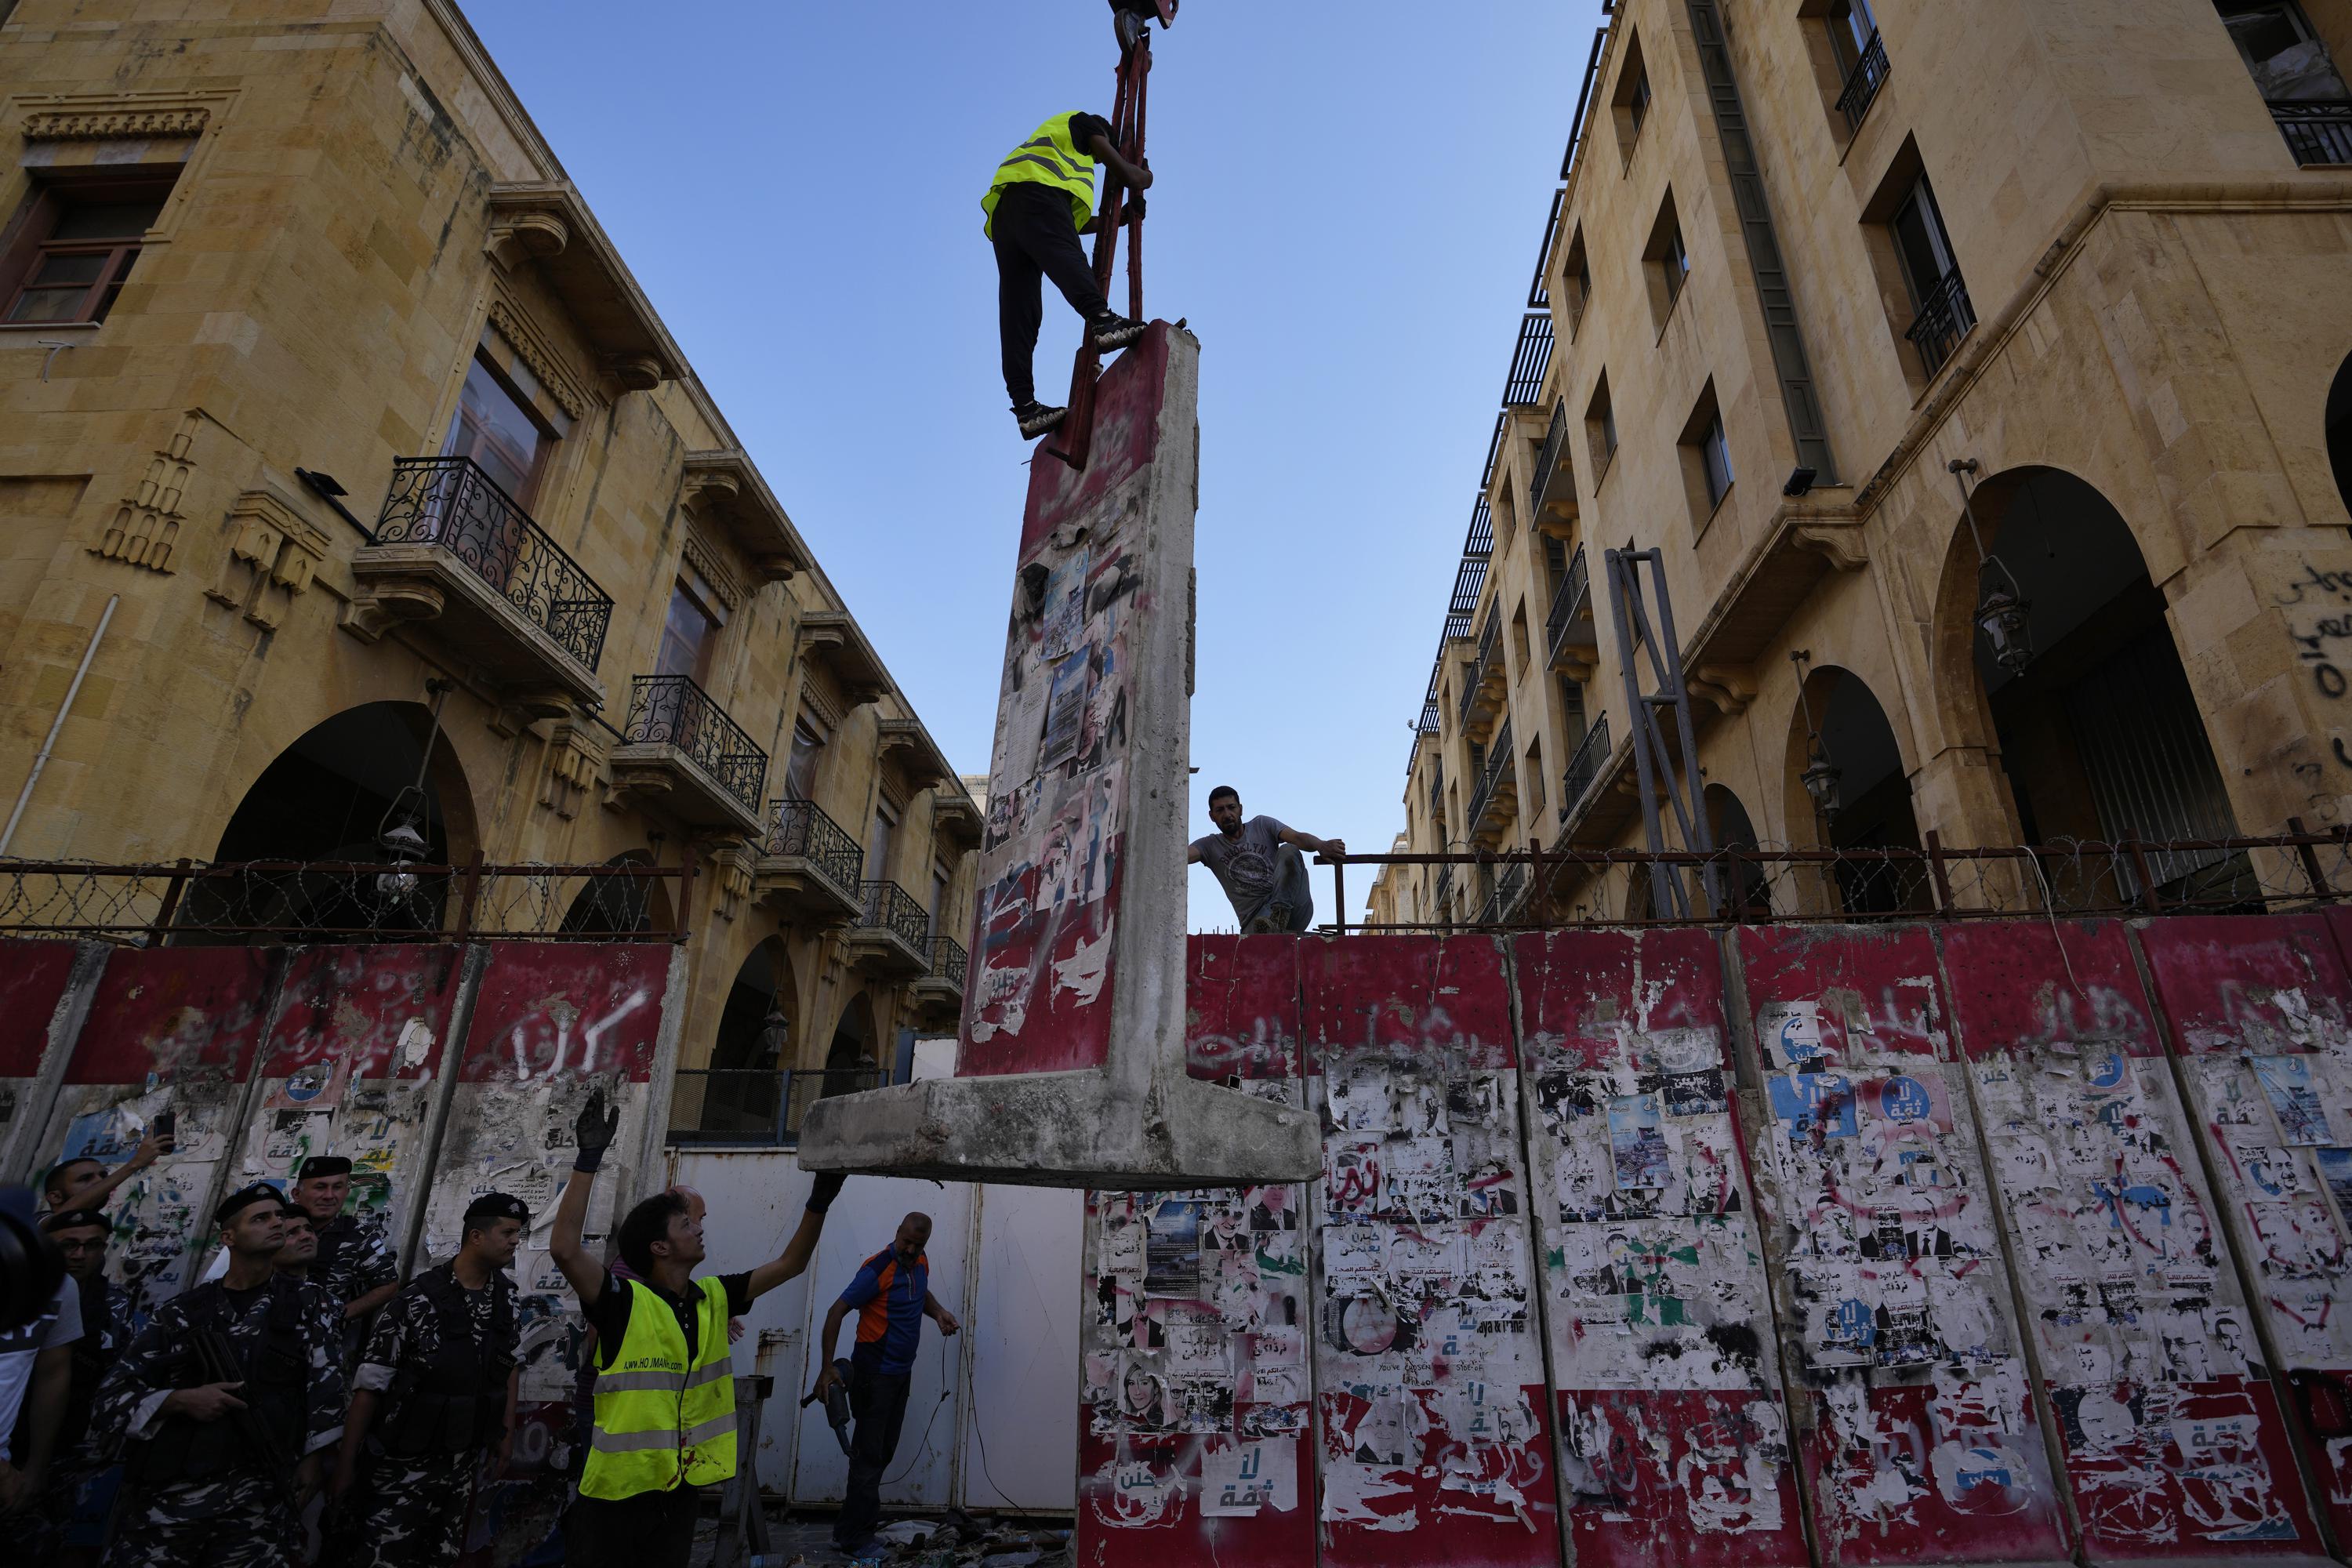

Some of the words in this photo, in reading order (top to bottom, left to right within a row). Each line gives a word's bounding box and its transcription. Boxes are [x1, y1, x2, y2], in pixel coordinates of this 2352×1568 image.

[1899, 1081, 1911, 1100] لا
[1890, 1100, 1922, 1117] ثقة
[370, 1118, 390, 1140] لا
[1239, 1448, 1261, 1479] لا
